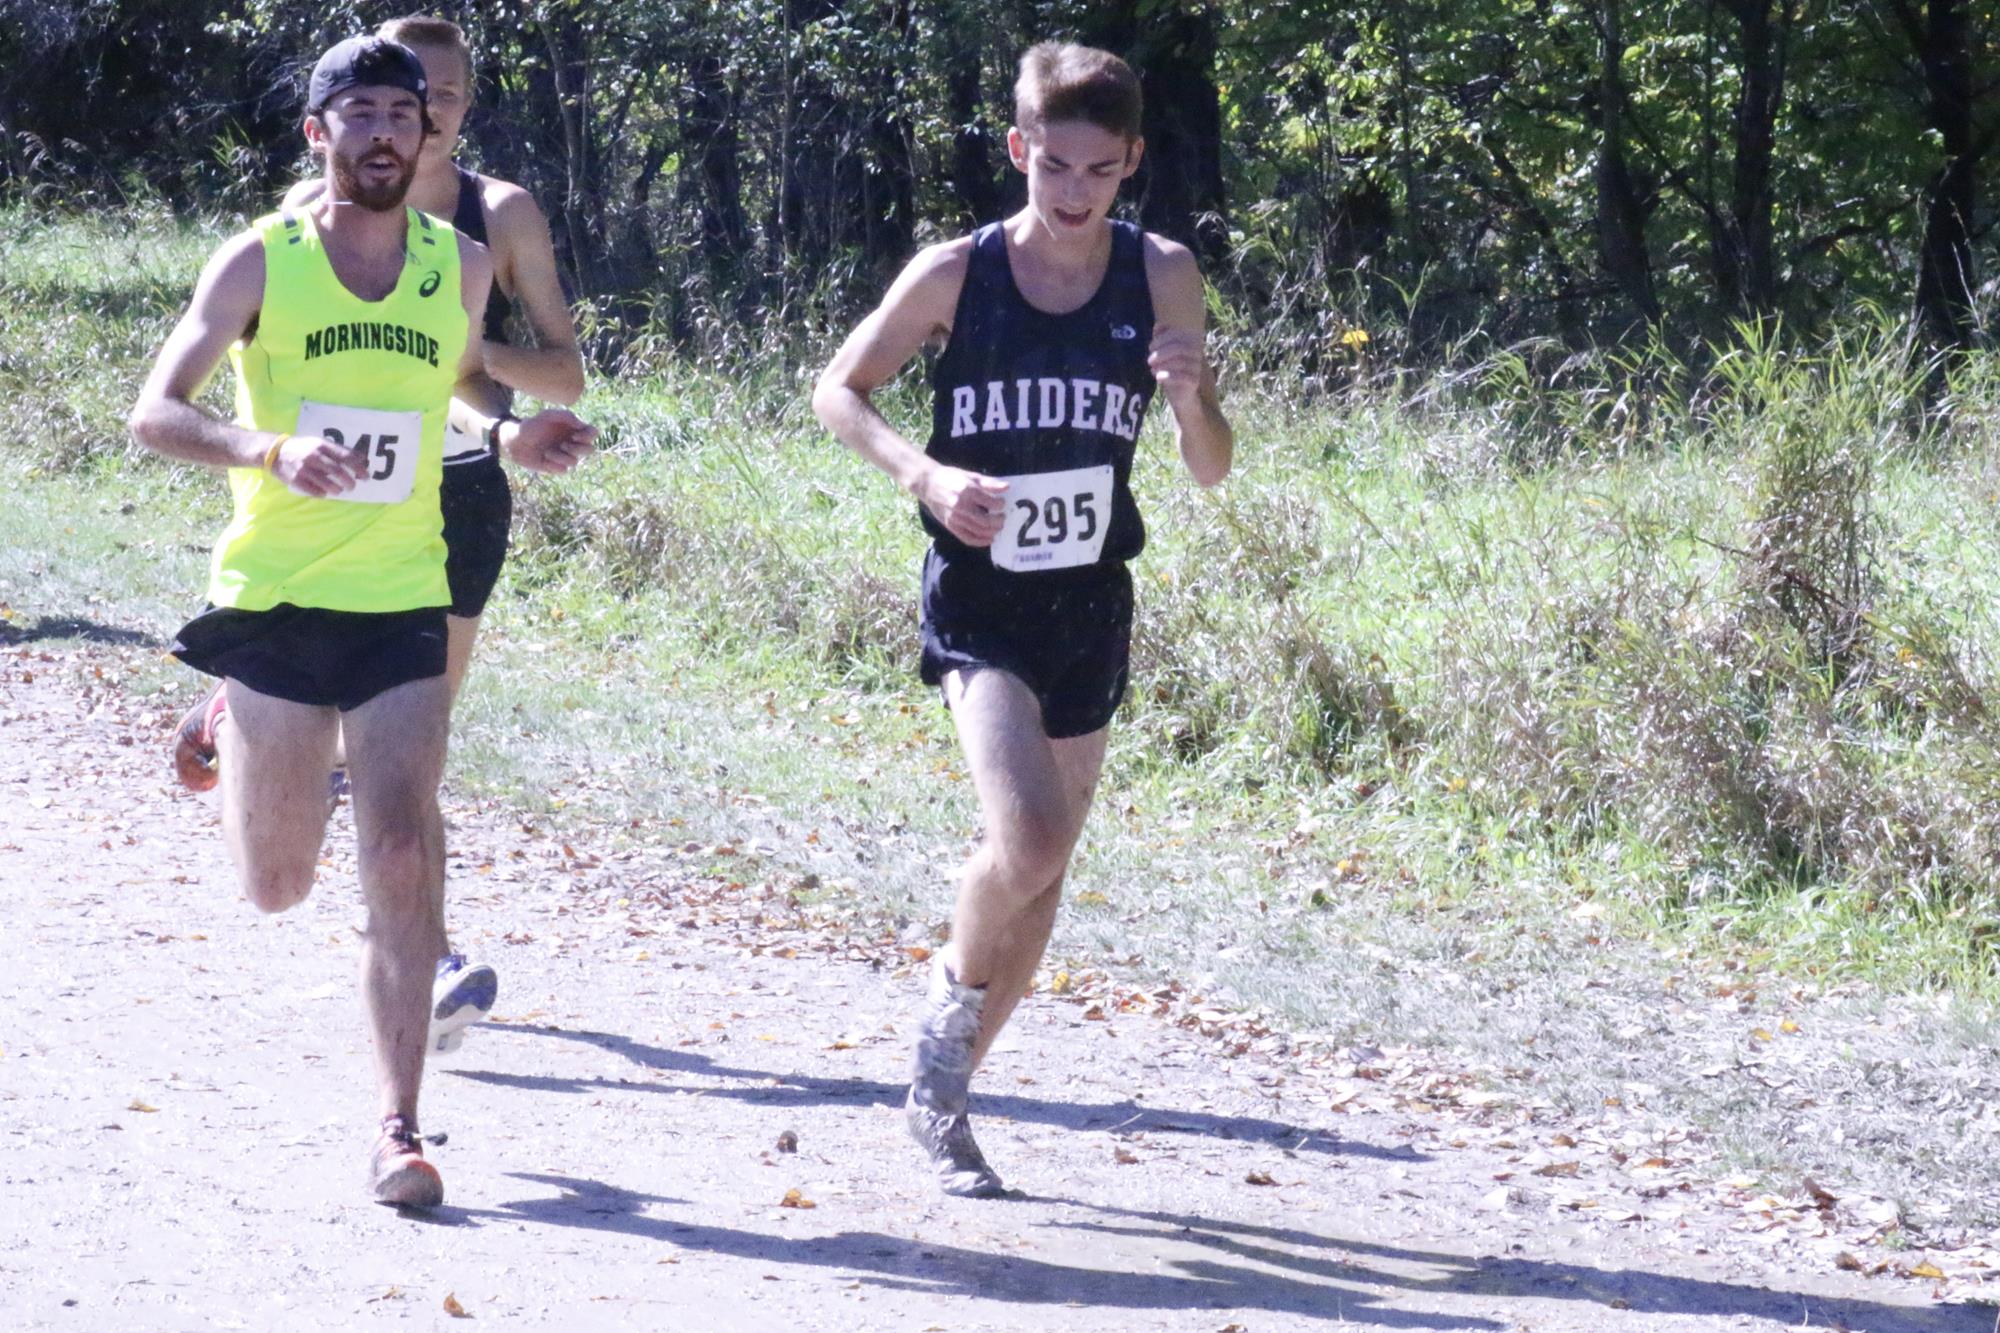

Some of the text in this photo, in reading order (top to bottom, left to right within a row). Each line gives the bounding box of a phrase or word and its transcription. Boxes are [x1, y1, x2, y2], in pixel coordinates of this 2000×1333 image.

[304, 322, 439, 368] MORNINGSIDE
[951, 377, 1142, 441] RAIDERS
[1015, 492, 1097, 548] 295
